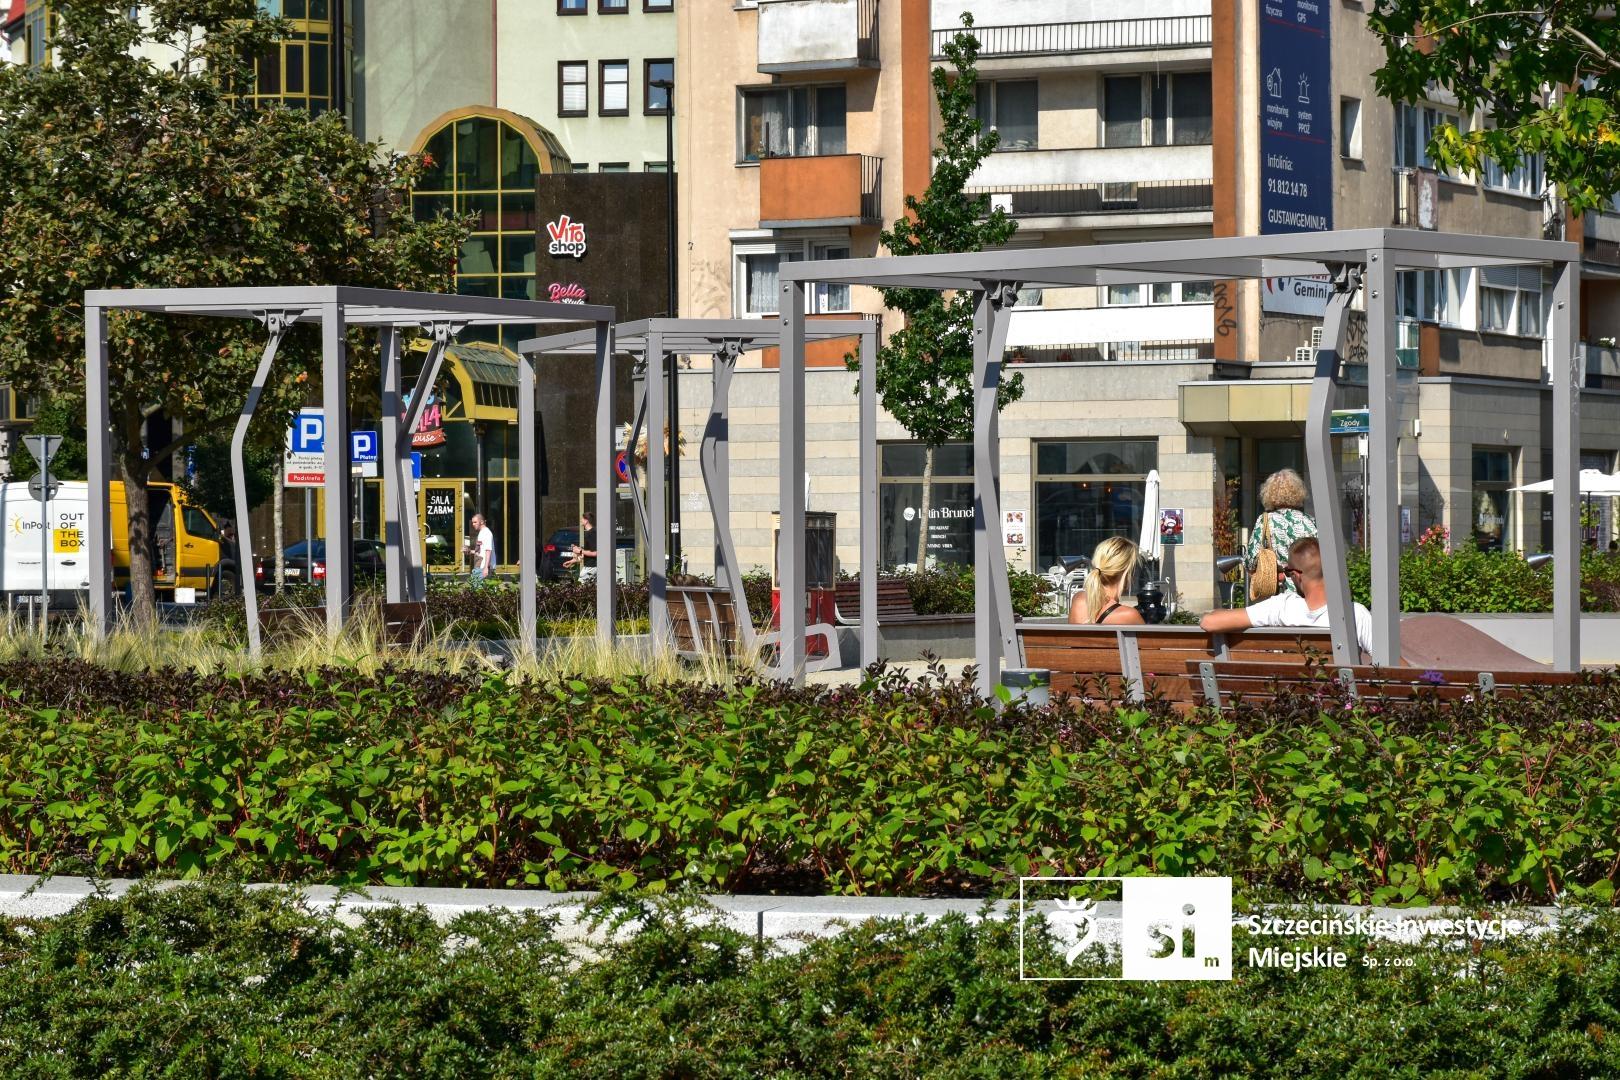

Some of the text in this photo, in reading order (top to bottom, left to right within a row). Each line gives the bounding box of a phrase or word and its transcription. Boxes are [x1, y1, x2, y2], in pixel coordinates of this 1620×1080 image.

[1297, 12, 1307, 23] GPS
[1267, 104, 1289, 118] monitoring
[1298, 110, 1312, 121] system
[1267, 118, 1282, 131] wizyjny
[1267, 153, 1294, 171] Infolinia:
[1267, 178, 1308, 198] 91 812 14 78
[1267, 208, 1328, 231] GUSTAWGEMINI.PL
[550, 240, 586, 256] shop
[548, 283, 586, 300] Bella
[1294, 281, 1328, 299] Gemini
[300, 418, 323, 449] P
[412, 433, 436, 442] ouse
[353, 434, 371, 459] P
[431, 495, 450, 505] SALA
[427, 506, 453, 515] ZABAW
[918, 507, 940, 519] Ltin
[22, 521, 50, 530] InPot
[60, 539, 85, 547] BOX
